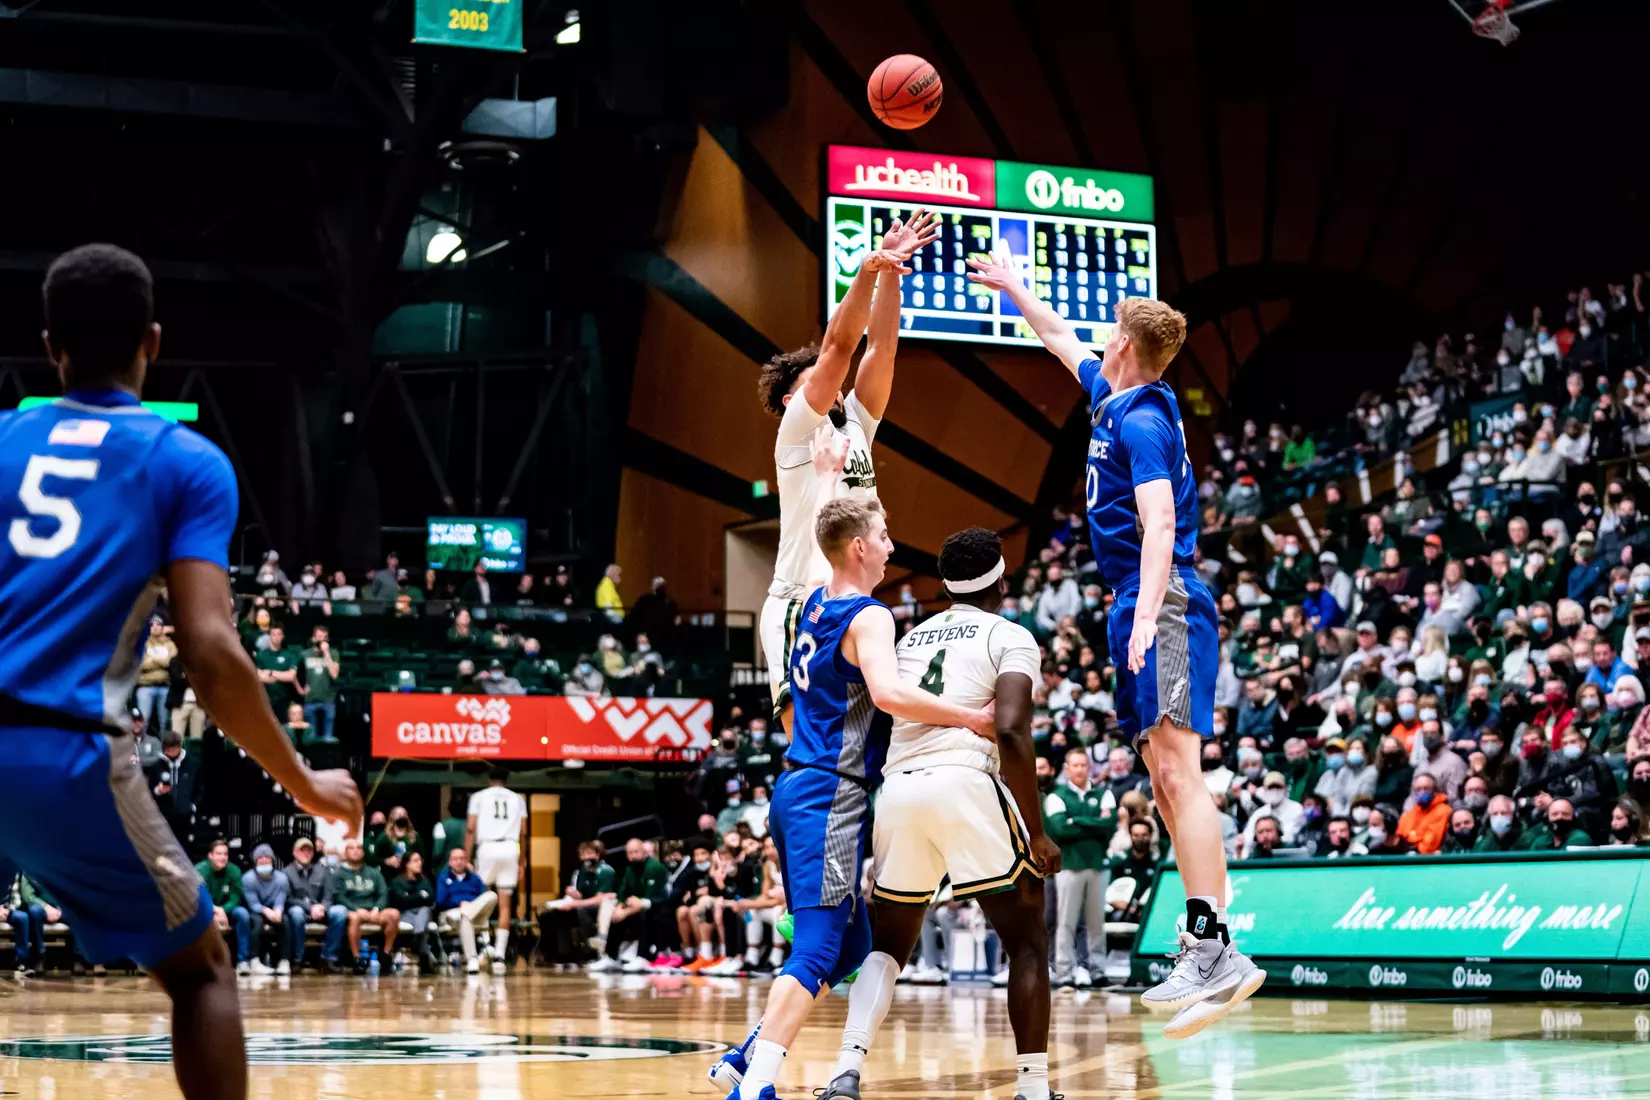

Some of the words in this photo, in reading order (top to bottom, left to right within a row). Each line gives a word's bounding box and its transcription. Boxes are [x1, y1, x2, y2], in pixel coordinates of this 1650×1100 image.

[448, 8, 489, 32] 2003
[856, 157, 969, 197] uchealth
[1060, 177, 1125, 212] fnbo
[8, 454, 101, 558] 5
[907, 625, 979, 648] STEVENS
[792, 630, 817, 692] 3
[918, 648, 947, 697] 4
[397, 722, 502, 744] canvas
[493, 800, 509, 820] 11
[1391, 883, 1542, 951] something
[1539, 903, 1622, 930] more
